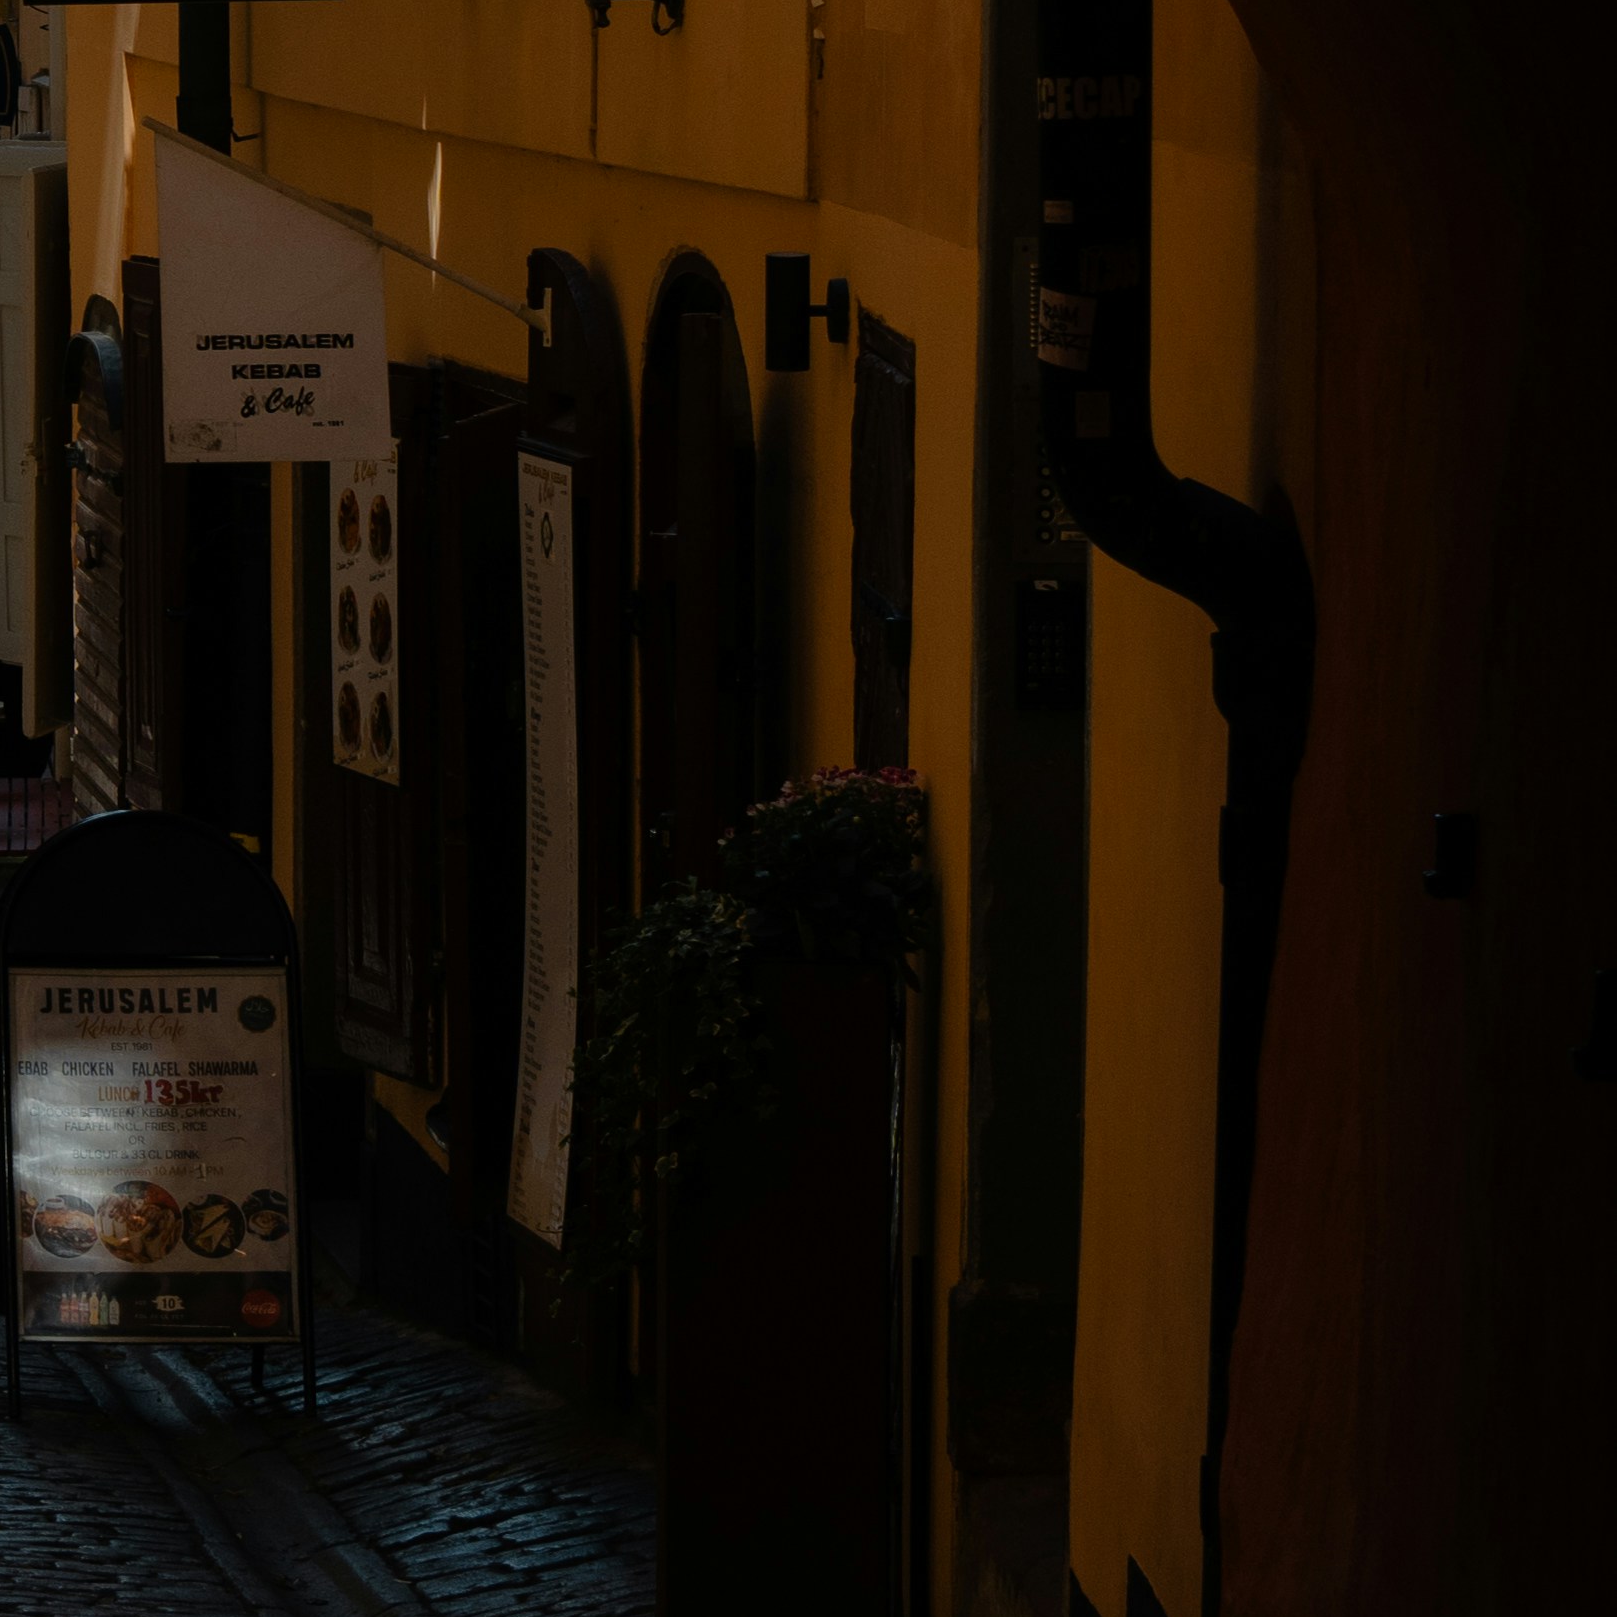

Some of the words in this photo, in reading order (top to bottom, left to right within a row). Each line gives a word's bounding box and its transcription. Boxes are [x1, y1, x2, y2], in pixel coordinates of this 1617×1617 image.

[196, 334, 354, 351] JERUSALEM
[231, 363, 321, 380] KEBAB
[265, 386, 316, 416] Cafe
[40, 987, 219, 1014] JERUSALEM
[76, 1016, 126, 1039] Kebab
[18, 1062, 49, 1076] EBAB
[62, 1062, 114, 1076] CHICKEN
[132, 1062, 181, 1077] FALAFEL
[188, 1062, 259, 1077] SHAWARMA
[144, 1079, 224, 1106] 135kr
[65, 1123, 111, 1132] FALAFEL
[183, 1123, 208, 1132] RICE
[129, 1135, 145, 1145] OR
[73, 1149, 118, 1160] BULGUR
[165, 1149, 200, 1160] DRINK
